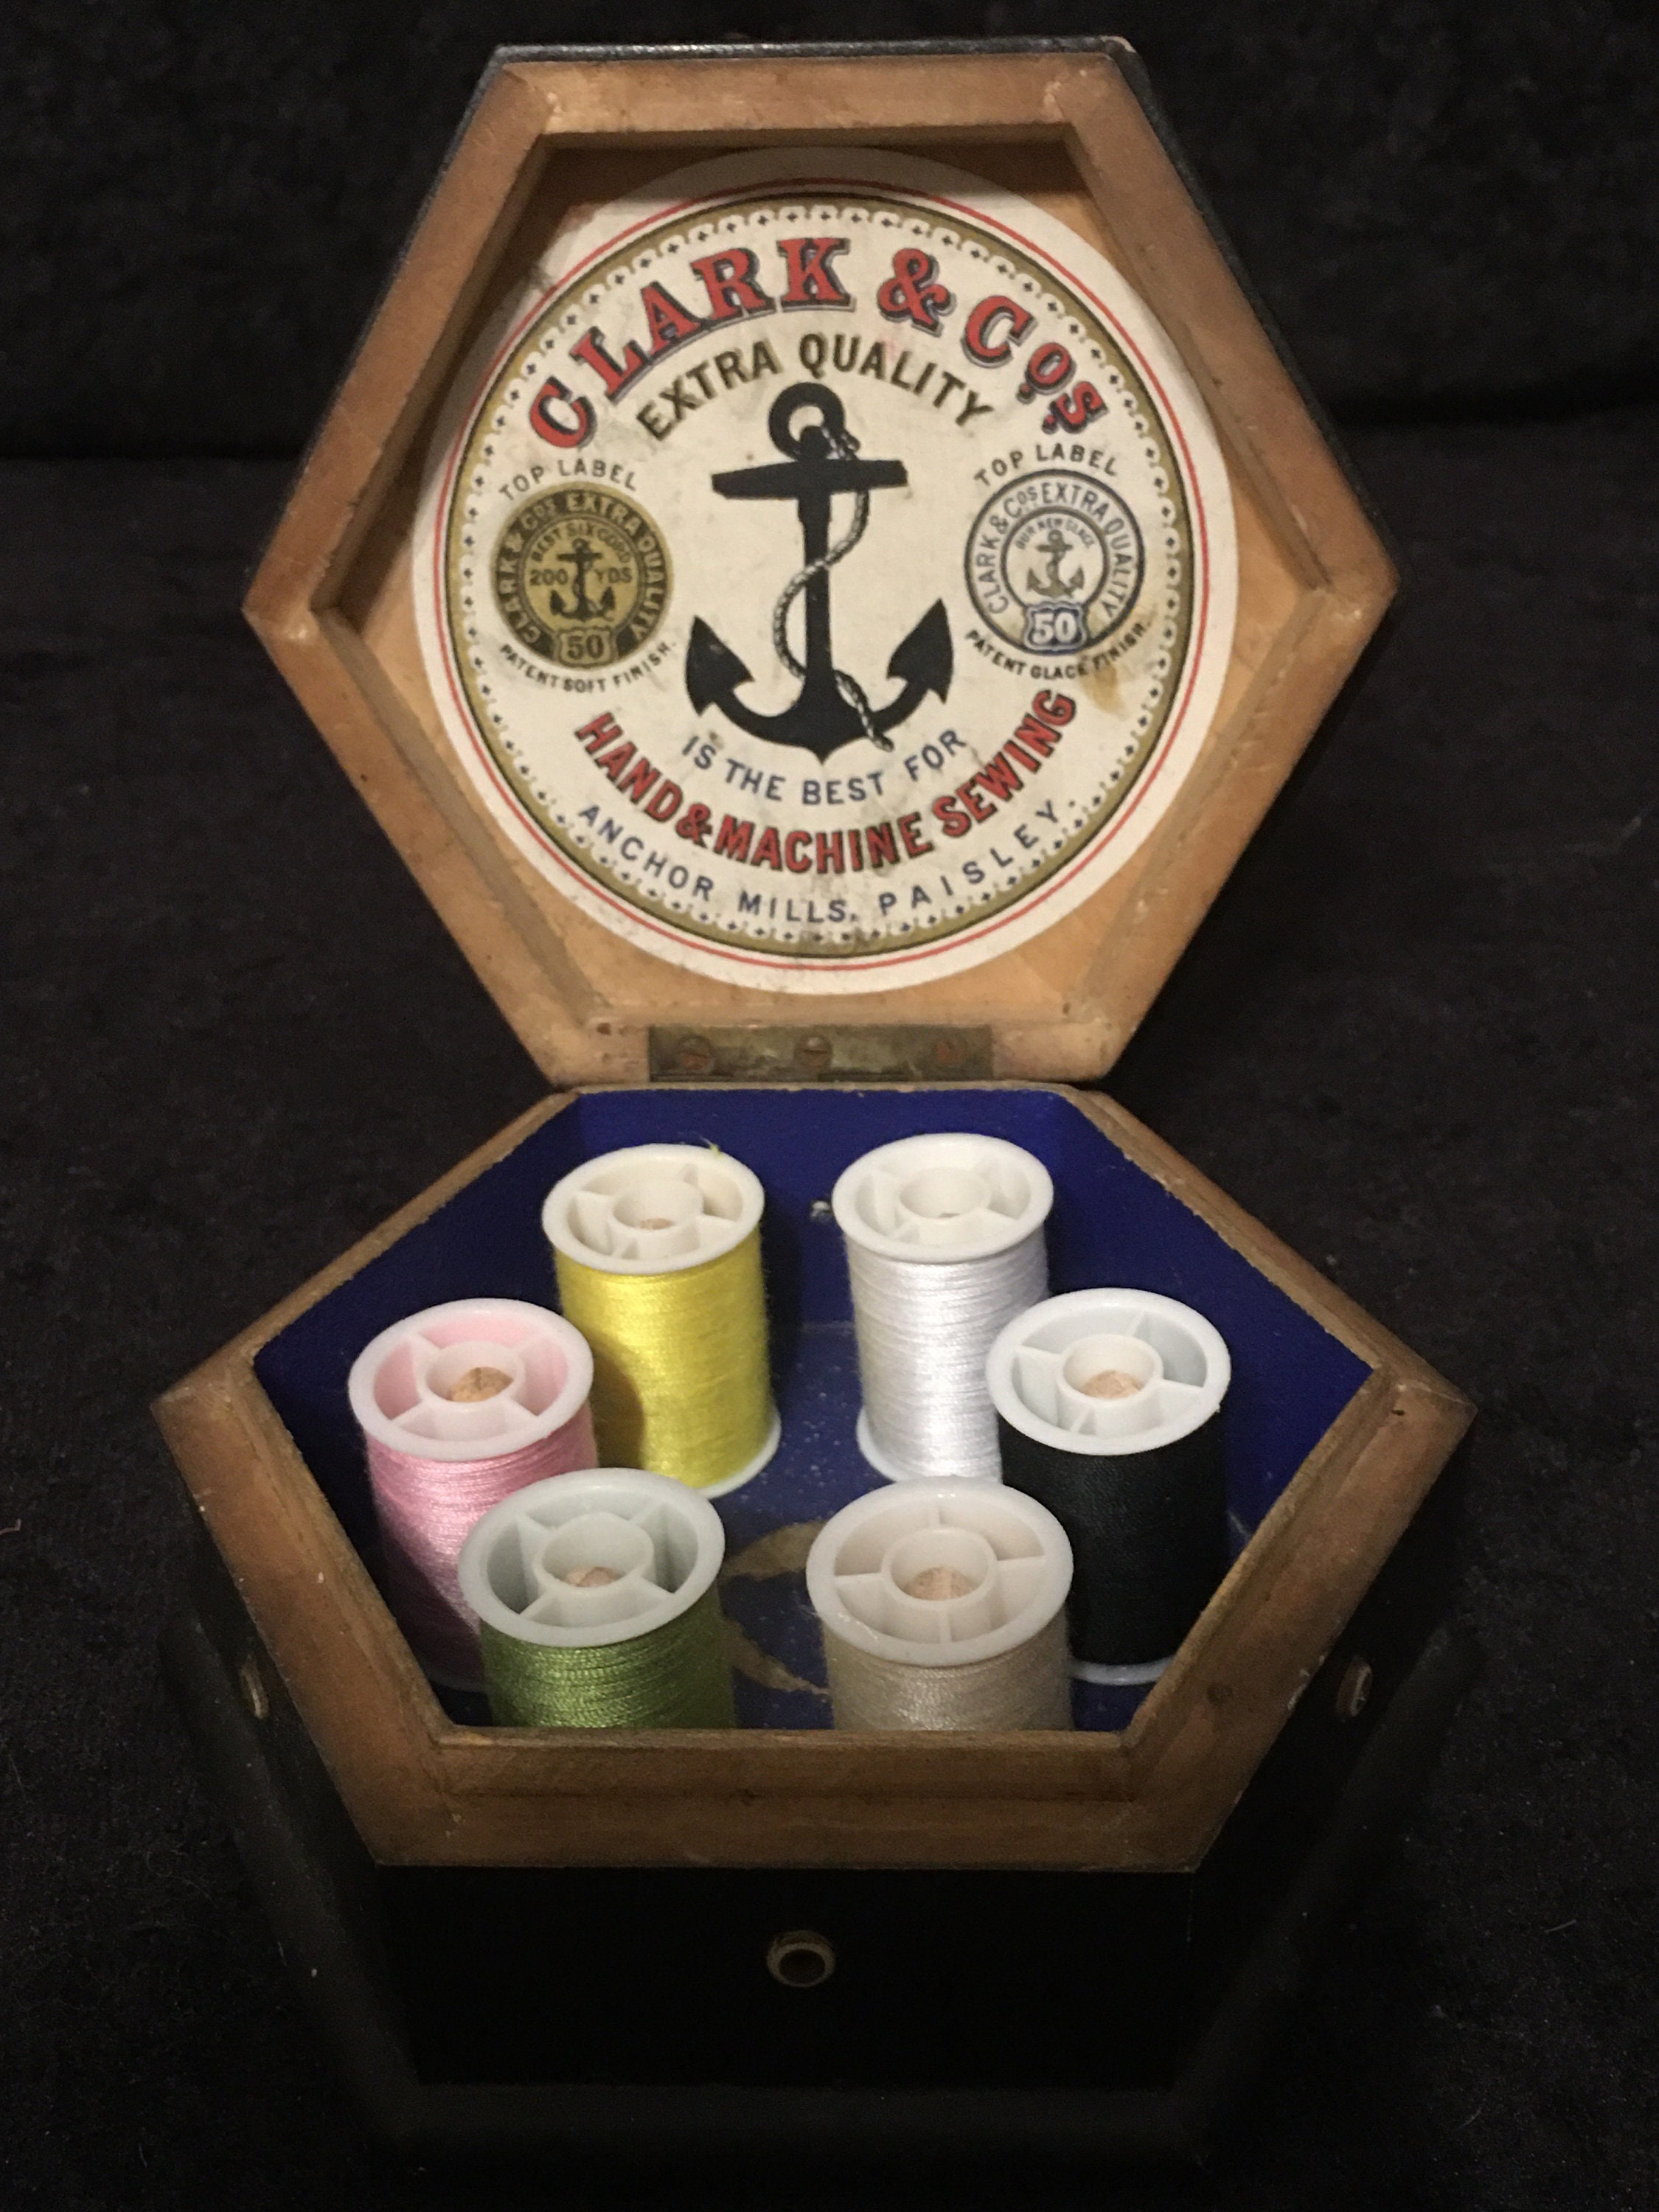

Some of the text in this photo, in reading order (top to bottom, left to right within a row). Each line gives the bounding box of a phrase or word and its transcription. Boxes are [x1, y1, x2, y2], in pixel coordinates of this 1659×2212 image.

[529, 237, 856, 449] CLARK
[877, 248, 956, 337] &
[635, 333, 997, 442] EXTRA QUALITY
[498, 459, 636, 501] TOP LABEL
[973, 442, 1117, 487] TOP LABEL
[990, 515, 1009, 535] &
[1041, 482, 1110, 522] EXTRA
[498, 561, 541, 644] CLARK
[566, 493, 642, 537] EXTRA
[637, 534, 664, 641] QUALITY
[530, 568, 568, 586] 200
[976, 532, 1009, 614] CLARK
[1100, 518, 1133, 617] QUALITY
[566, 634, 605, 661] 50
[965, 630, 1026, 675] PATENT
[1032, 611, 1078, 644] 50
[499, 644, 557, 684] PATENT
[563, 678, 606, 694] SOFT
[682, 728, 967, 805] IS THE BEST FOR
[931, 688, 1077, 837] SEWING
[579, 804, 715, 901] ANCHOR
